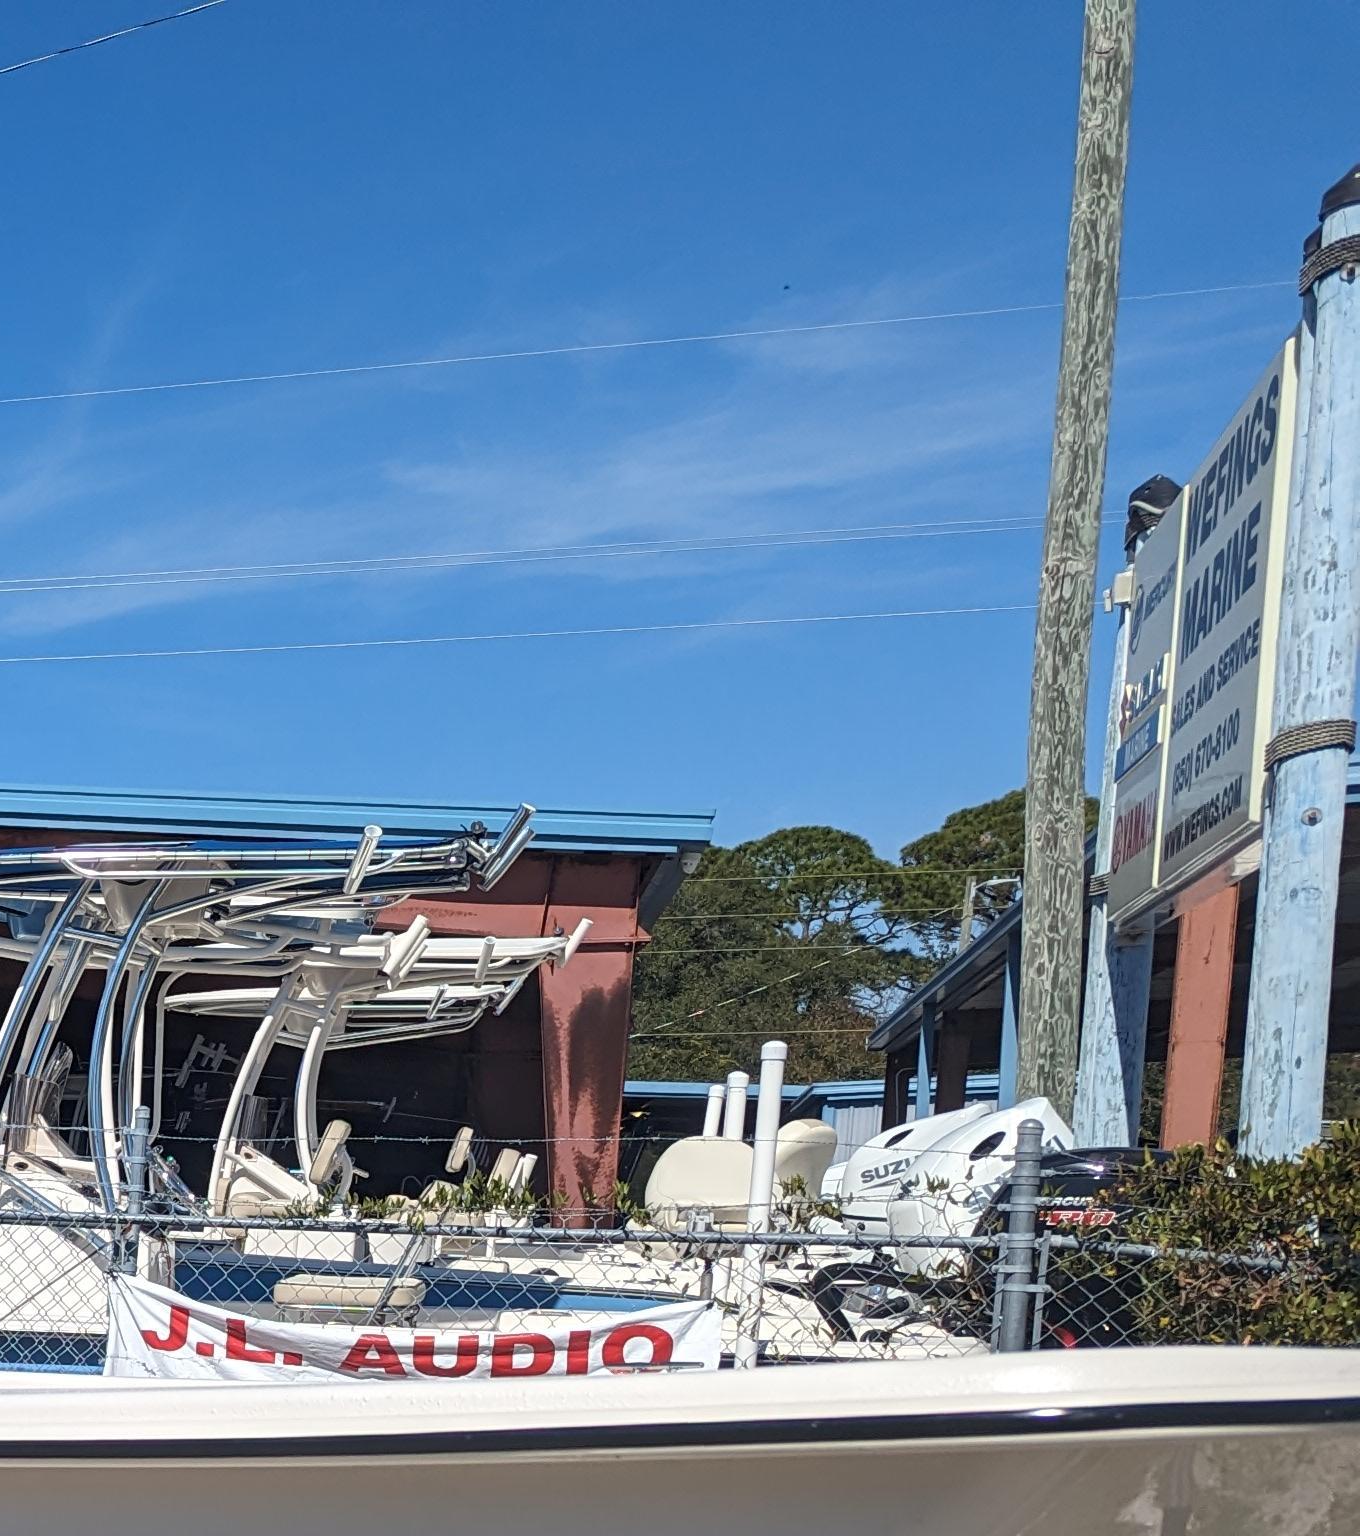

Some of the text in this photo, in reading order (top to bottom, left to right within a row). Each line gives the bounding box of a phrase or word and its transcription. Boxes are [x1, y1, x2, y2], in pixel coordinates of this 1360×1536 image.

[1185, 374, 1279, 565] WEFINGS
[1180, 501, 1262, 666] MARINE
[1196, 664, 1216, 713] AND
[1216, 617, 1261, 693] SERVICE
[1194, 707, 1240, 779] 670-8100
[141, 1307, 675, 1380] J.L. AUDIO
